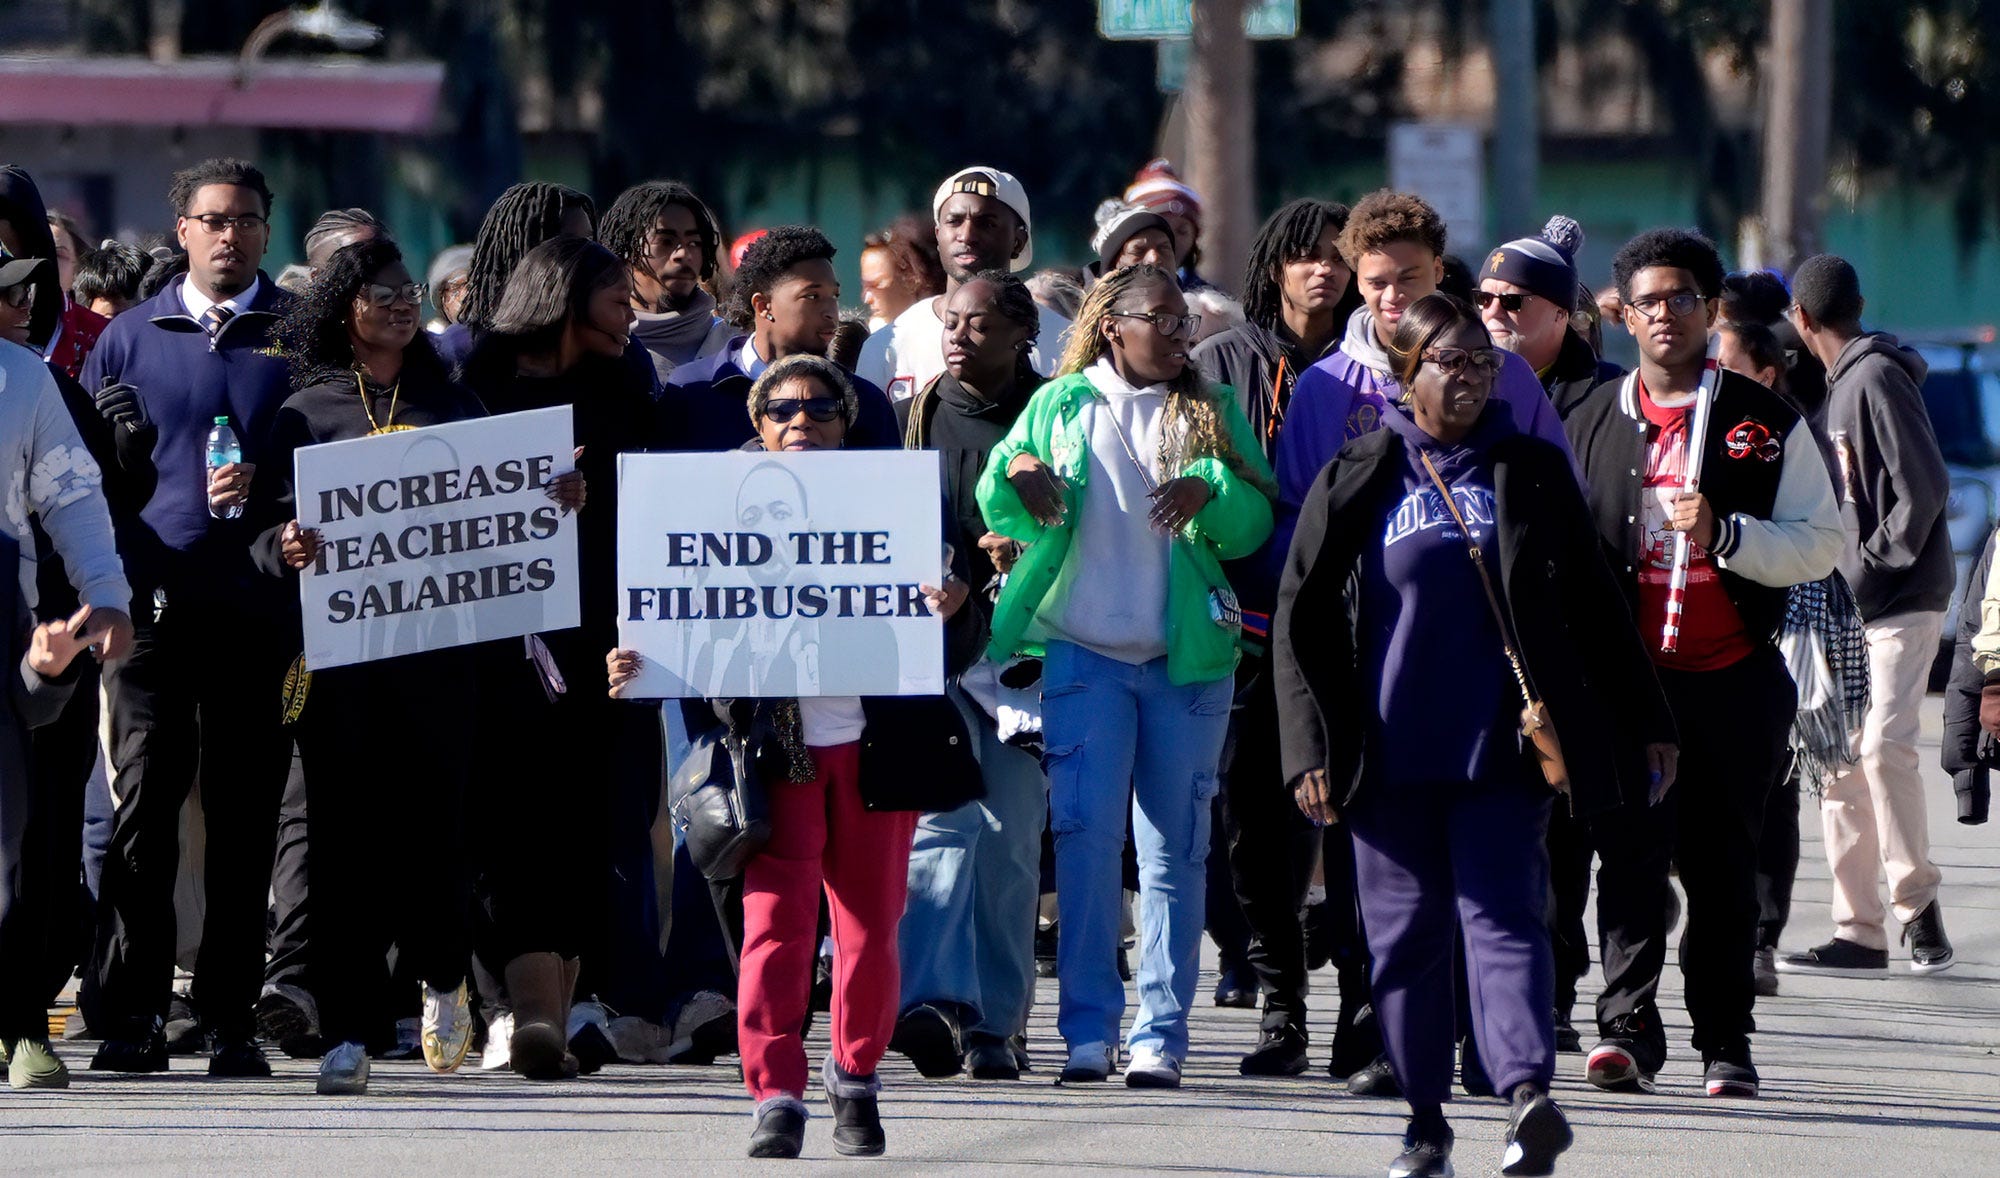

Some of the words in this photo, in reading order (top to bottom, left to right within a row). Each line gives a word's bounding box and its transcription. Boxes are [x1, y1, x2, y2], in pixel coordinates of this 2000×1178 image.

[318, 455, 554, 524] INCREASE
[313, 506, 559, 577] TEACHERS
[666, 532, 774, 567] END
[788, 530, 892, 565] THE
[327, 557, 556, 624] SALARIES
[626, 582, 934, 622] FILIBUSTER
